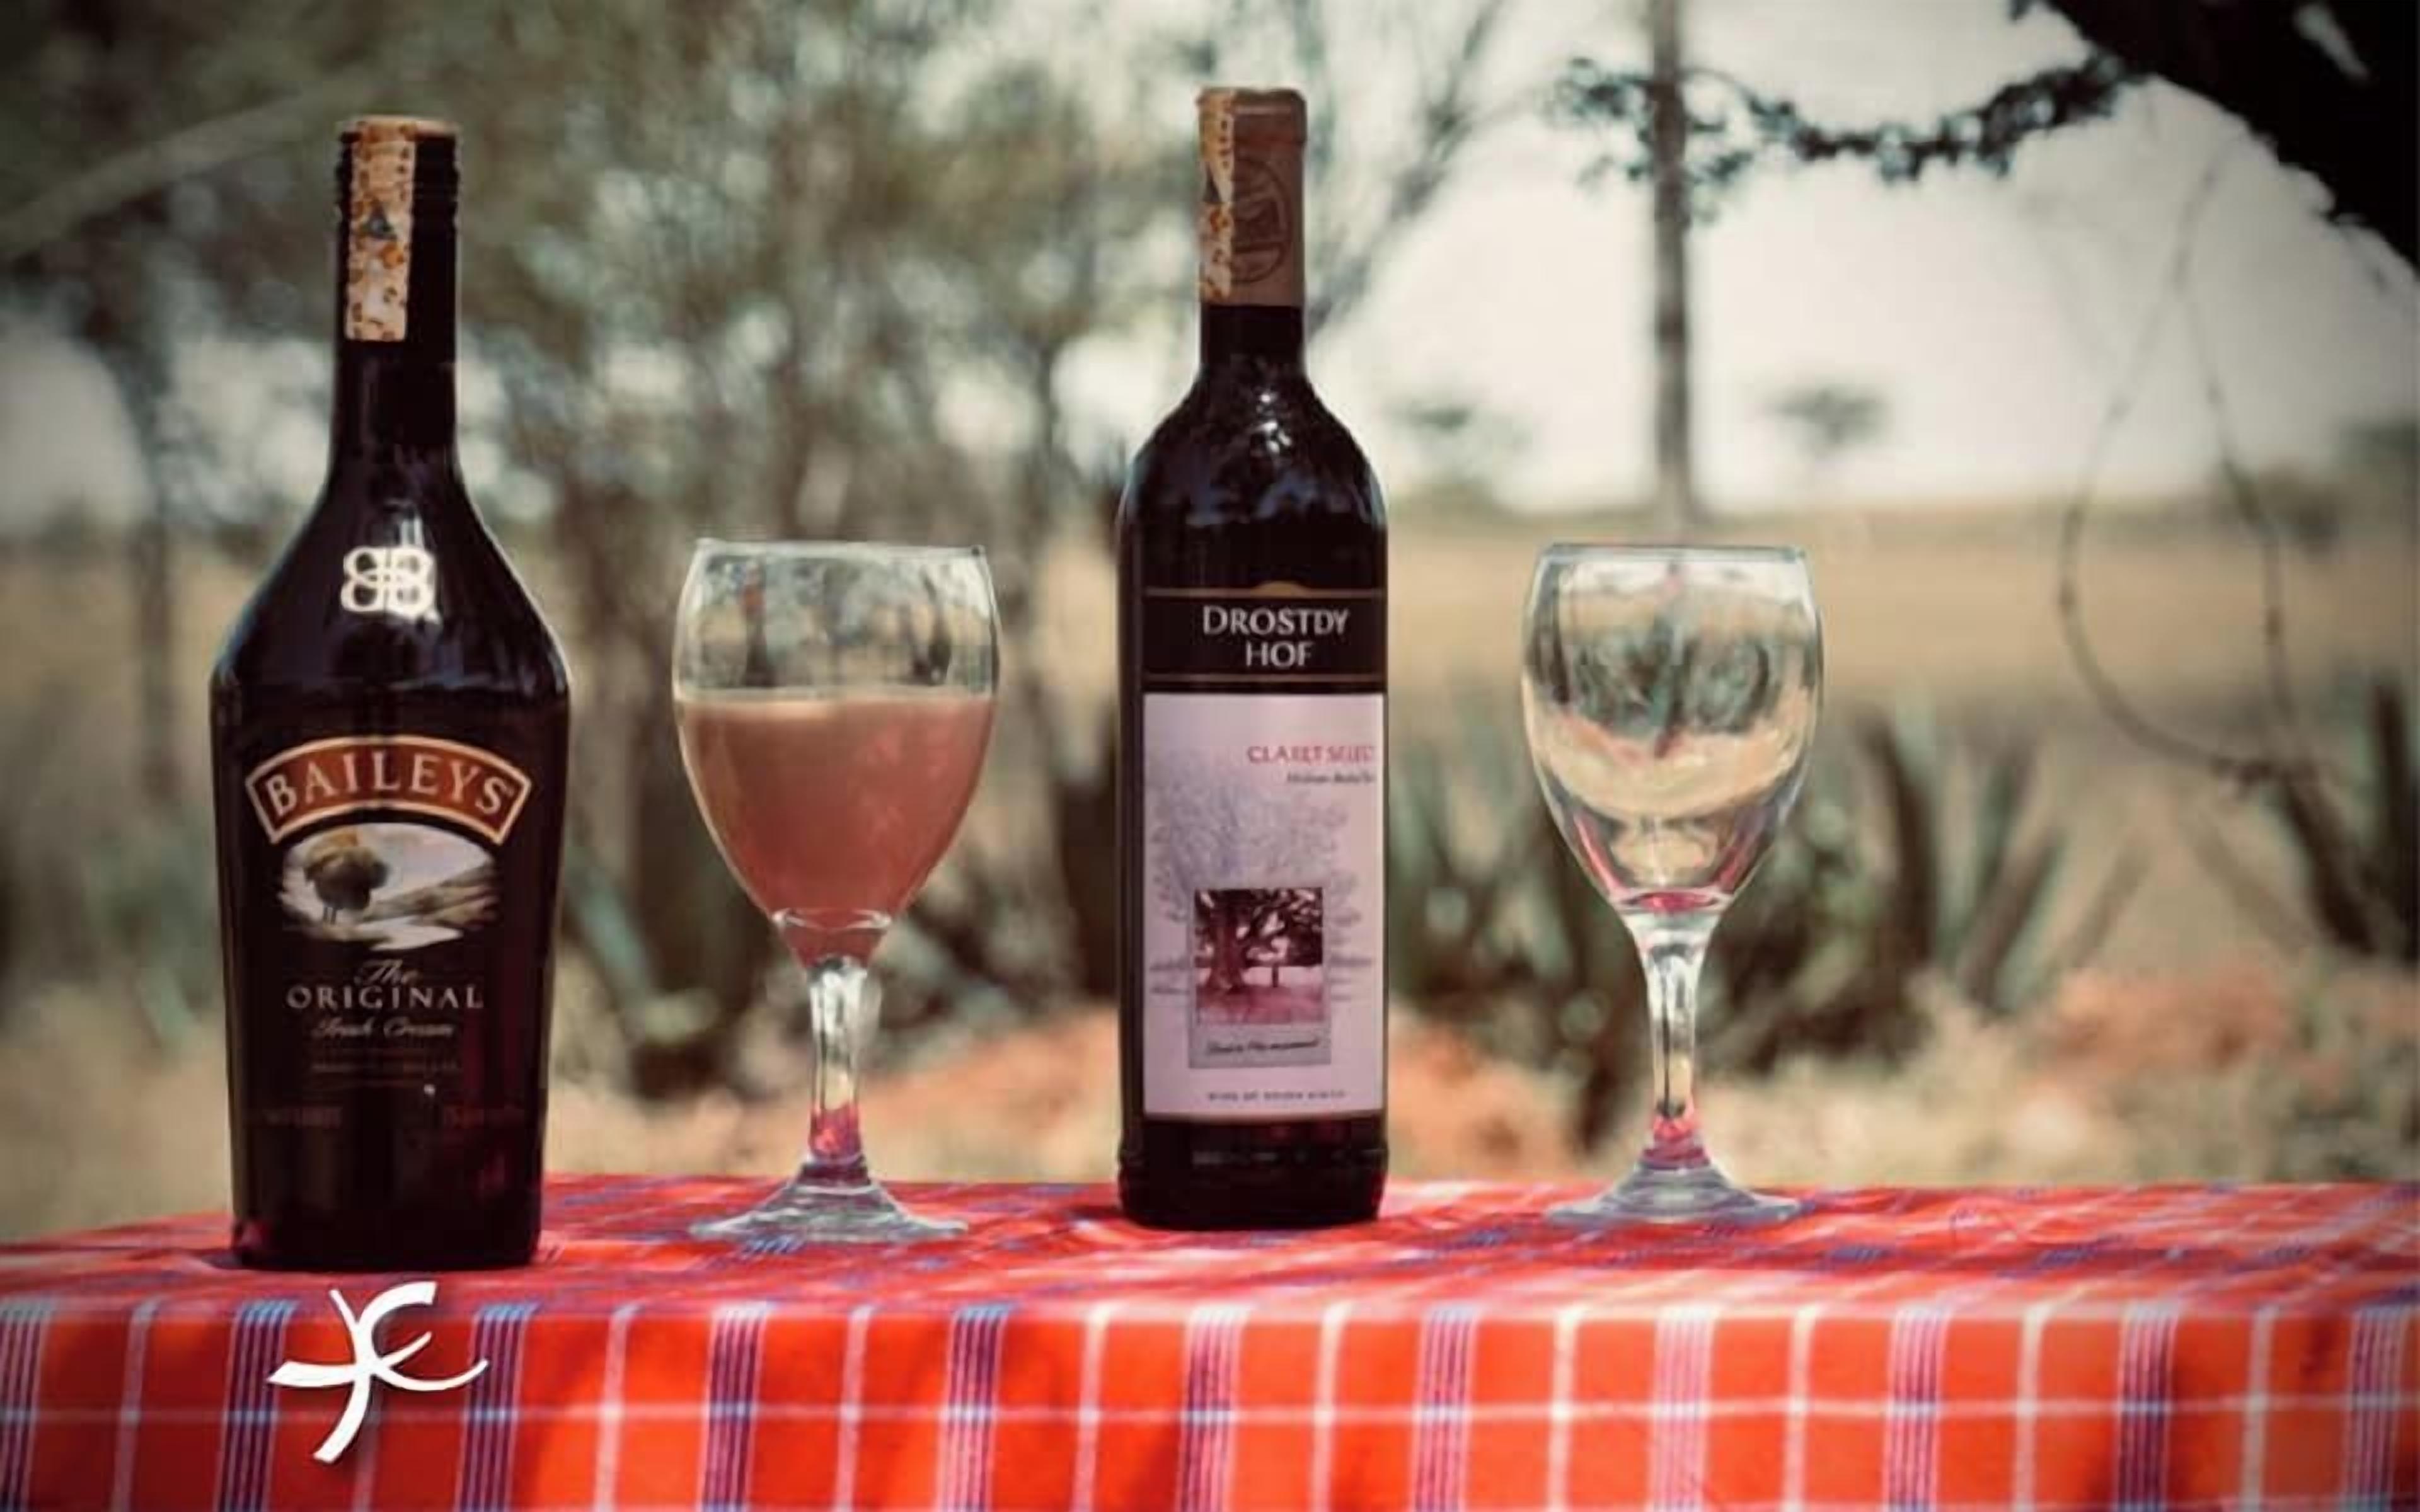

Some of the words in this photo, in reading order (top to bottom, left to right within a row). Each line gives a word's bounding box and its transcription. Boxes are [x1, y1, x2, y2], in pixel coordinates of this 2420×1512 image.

[1202, 605, 1350, 636] DROSTDY
[1245, 641, 1314, 667] HOF
[265, 750, 507, 817] BAILEYS
[285, 983, 485, 1009] ORIGINAL
